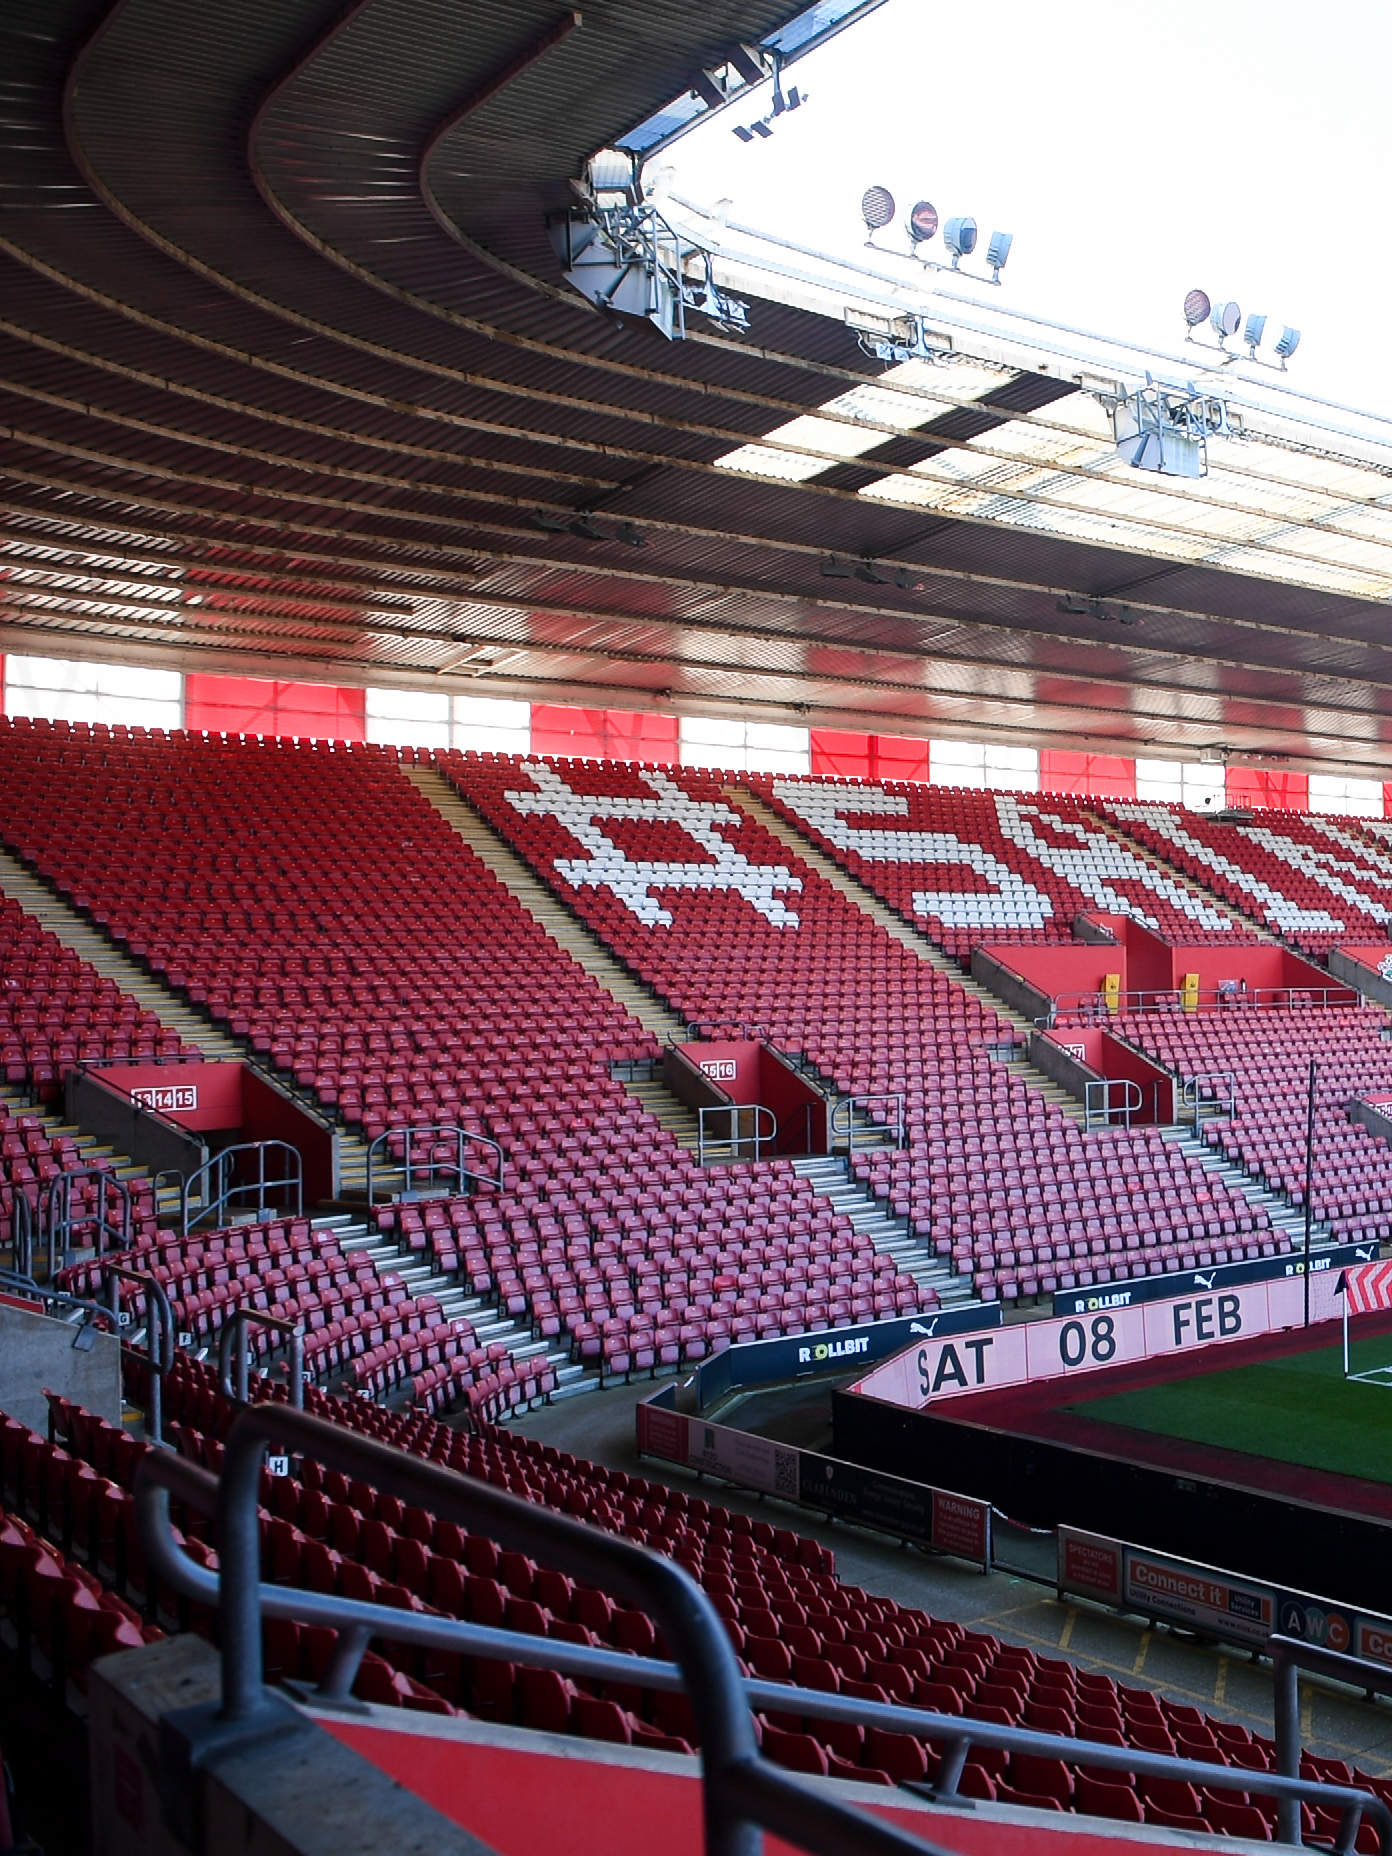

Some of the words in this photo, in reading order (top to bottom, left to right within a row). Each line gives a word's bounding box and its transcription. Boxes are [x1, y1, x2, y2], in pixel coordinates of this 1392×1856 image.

[719, 1063, 733, 1076] 16
[155, 1091, 173, 1107] 14
[176, 1090, 193, 1105] 15
[1285, 1257, 1332, 1276] ROLBIT
[1075, 1291, 1132, 1313] ROLLBIT
[798, 1336, 869, 1362] ROLLBIT
[917, 1337, 993, 1397] SAT
[1059, 1315, 1116, 1367] 08
[1172, 1294, 1243, 1346] FEB
[274, 1459, 284, 1474] H
[938, 1498, 980, 1520] WARNING
[1069, 1543, 1113, 1565] SPECTATORS
[1135, 1565, 1205, 1600] Connect
[1210, 1586, 1222, 1605] it
[1129, 1588, 1151, 1602] Utility
[1152, 1594, 1196, 1616] Connections
[1230, 1601, 1260, 1617] Services
